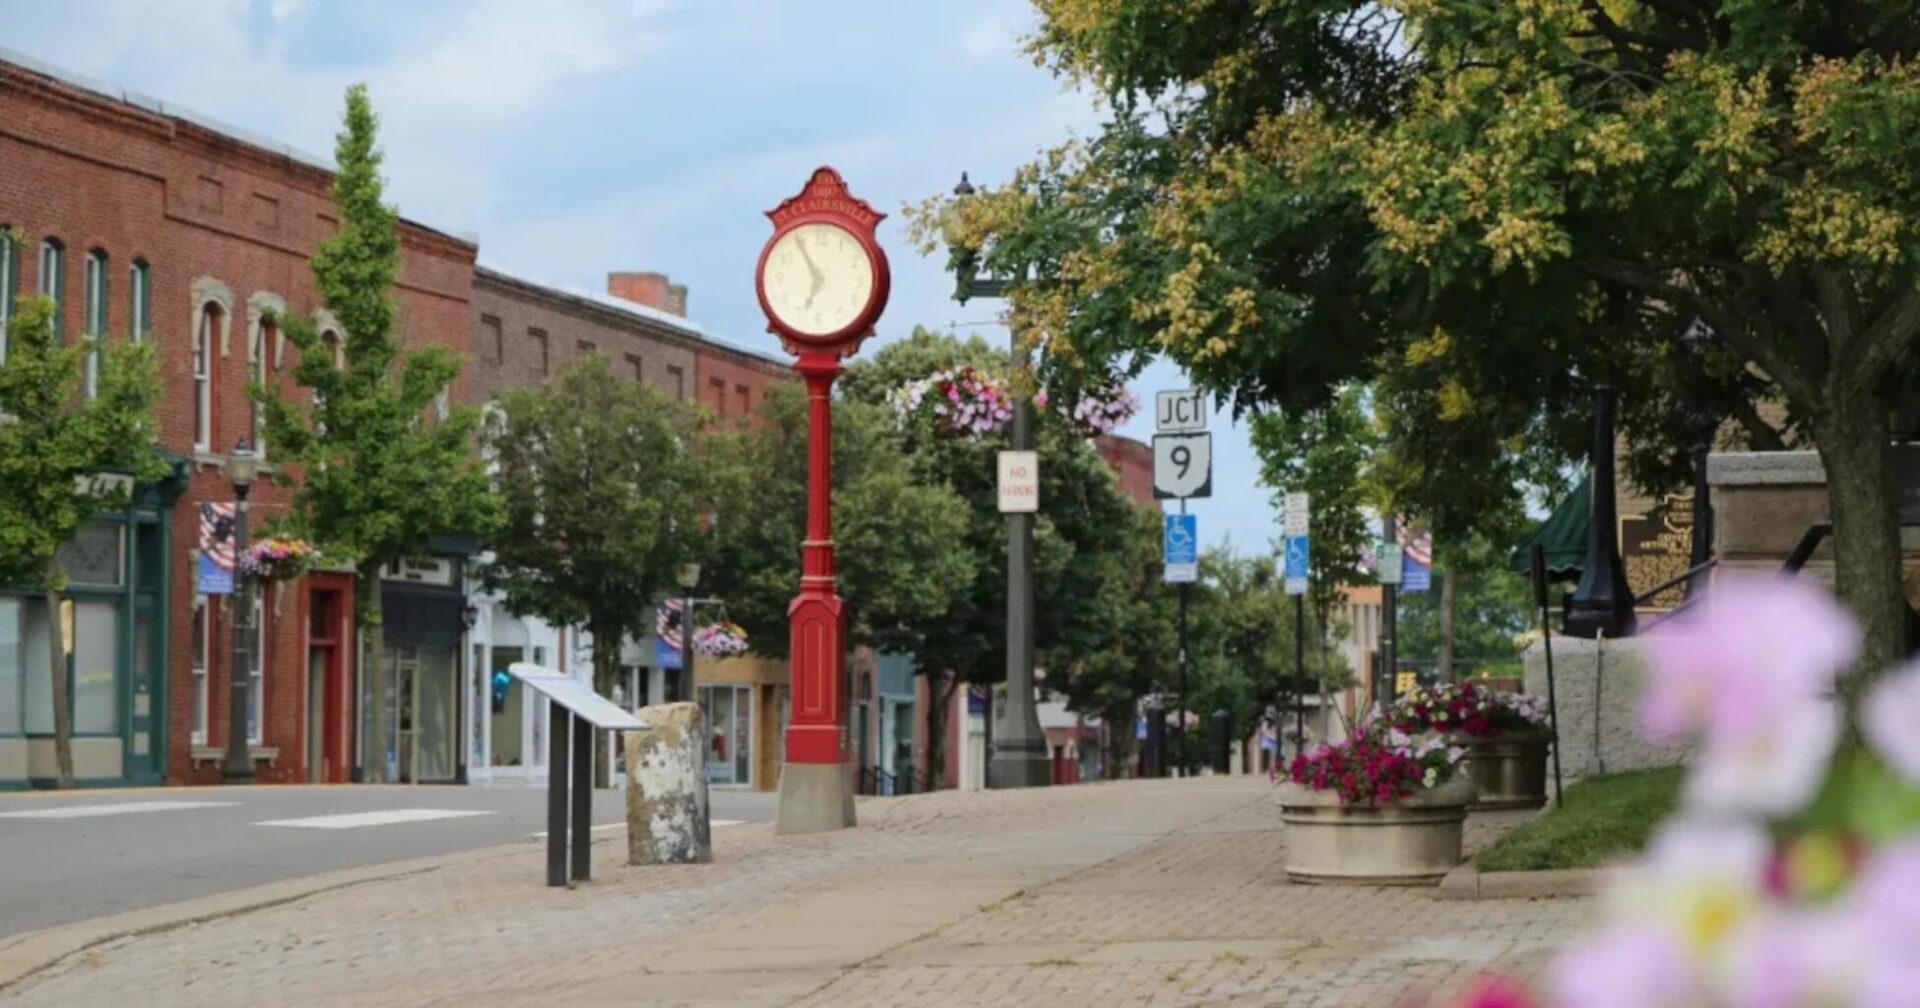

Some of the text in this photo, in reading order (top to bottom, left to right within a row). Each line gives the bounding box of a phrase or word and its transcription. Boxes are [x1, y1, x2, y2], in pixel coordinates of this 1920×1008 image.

[1161, 396, 1201, 424] JCT
[1009, 466, 1026, 479] NO
[1170, 445, 1191, 480] 9
